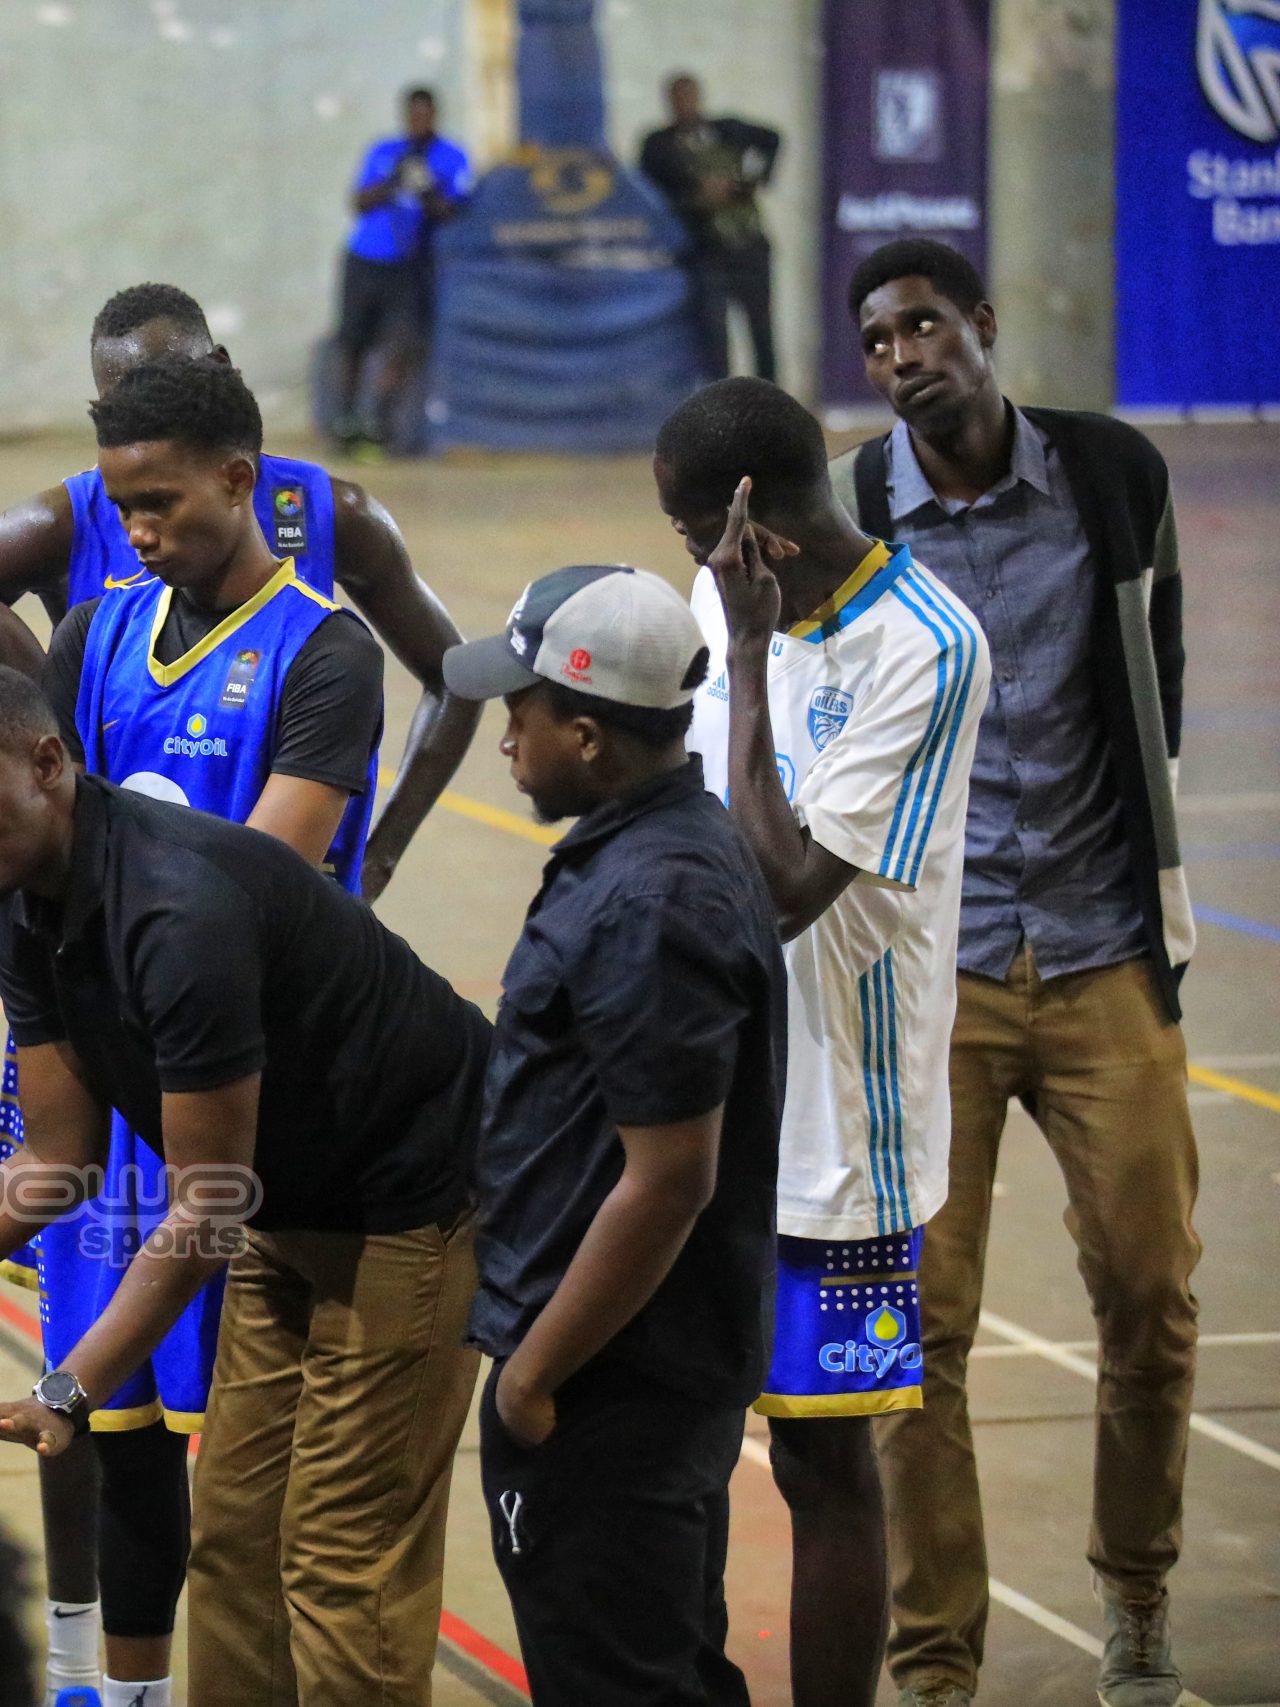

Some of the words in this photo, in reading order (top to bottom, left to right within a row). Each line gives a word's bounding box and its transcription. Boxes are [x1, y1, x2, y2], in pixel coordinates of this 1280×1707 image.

[1187, 151, 1280, 198] Stan
[278, 527, 303, 538] FIBA
[226, 683, 247, 694] FIBA
